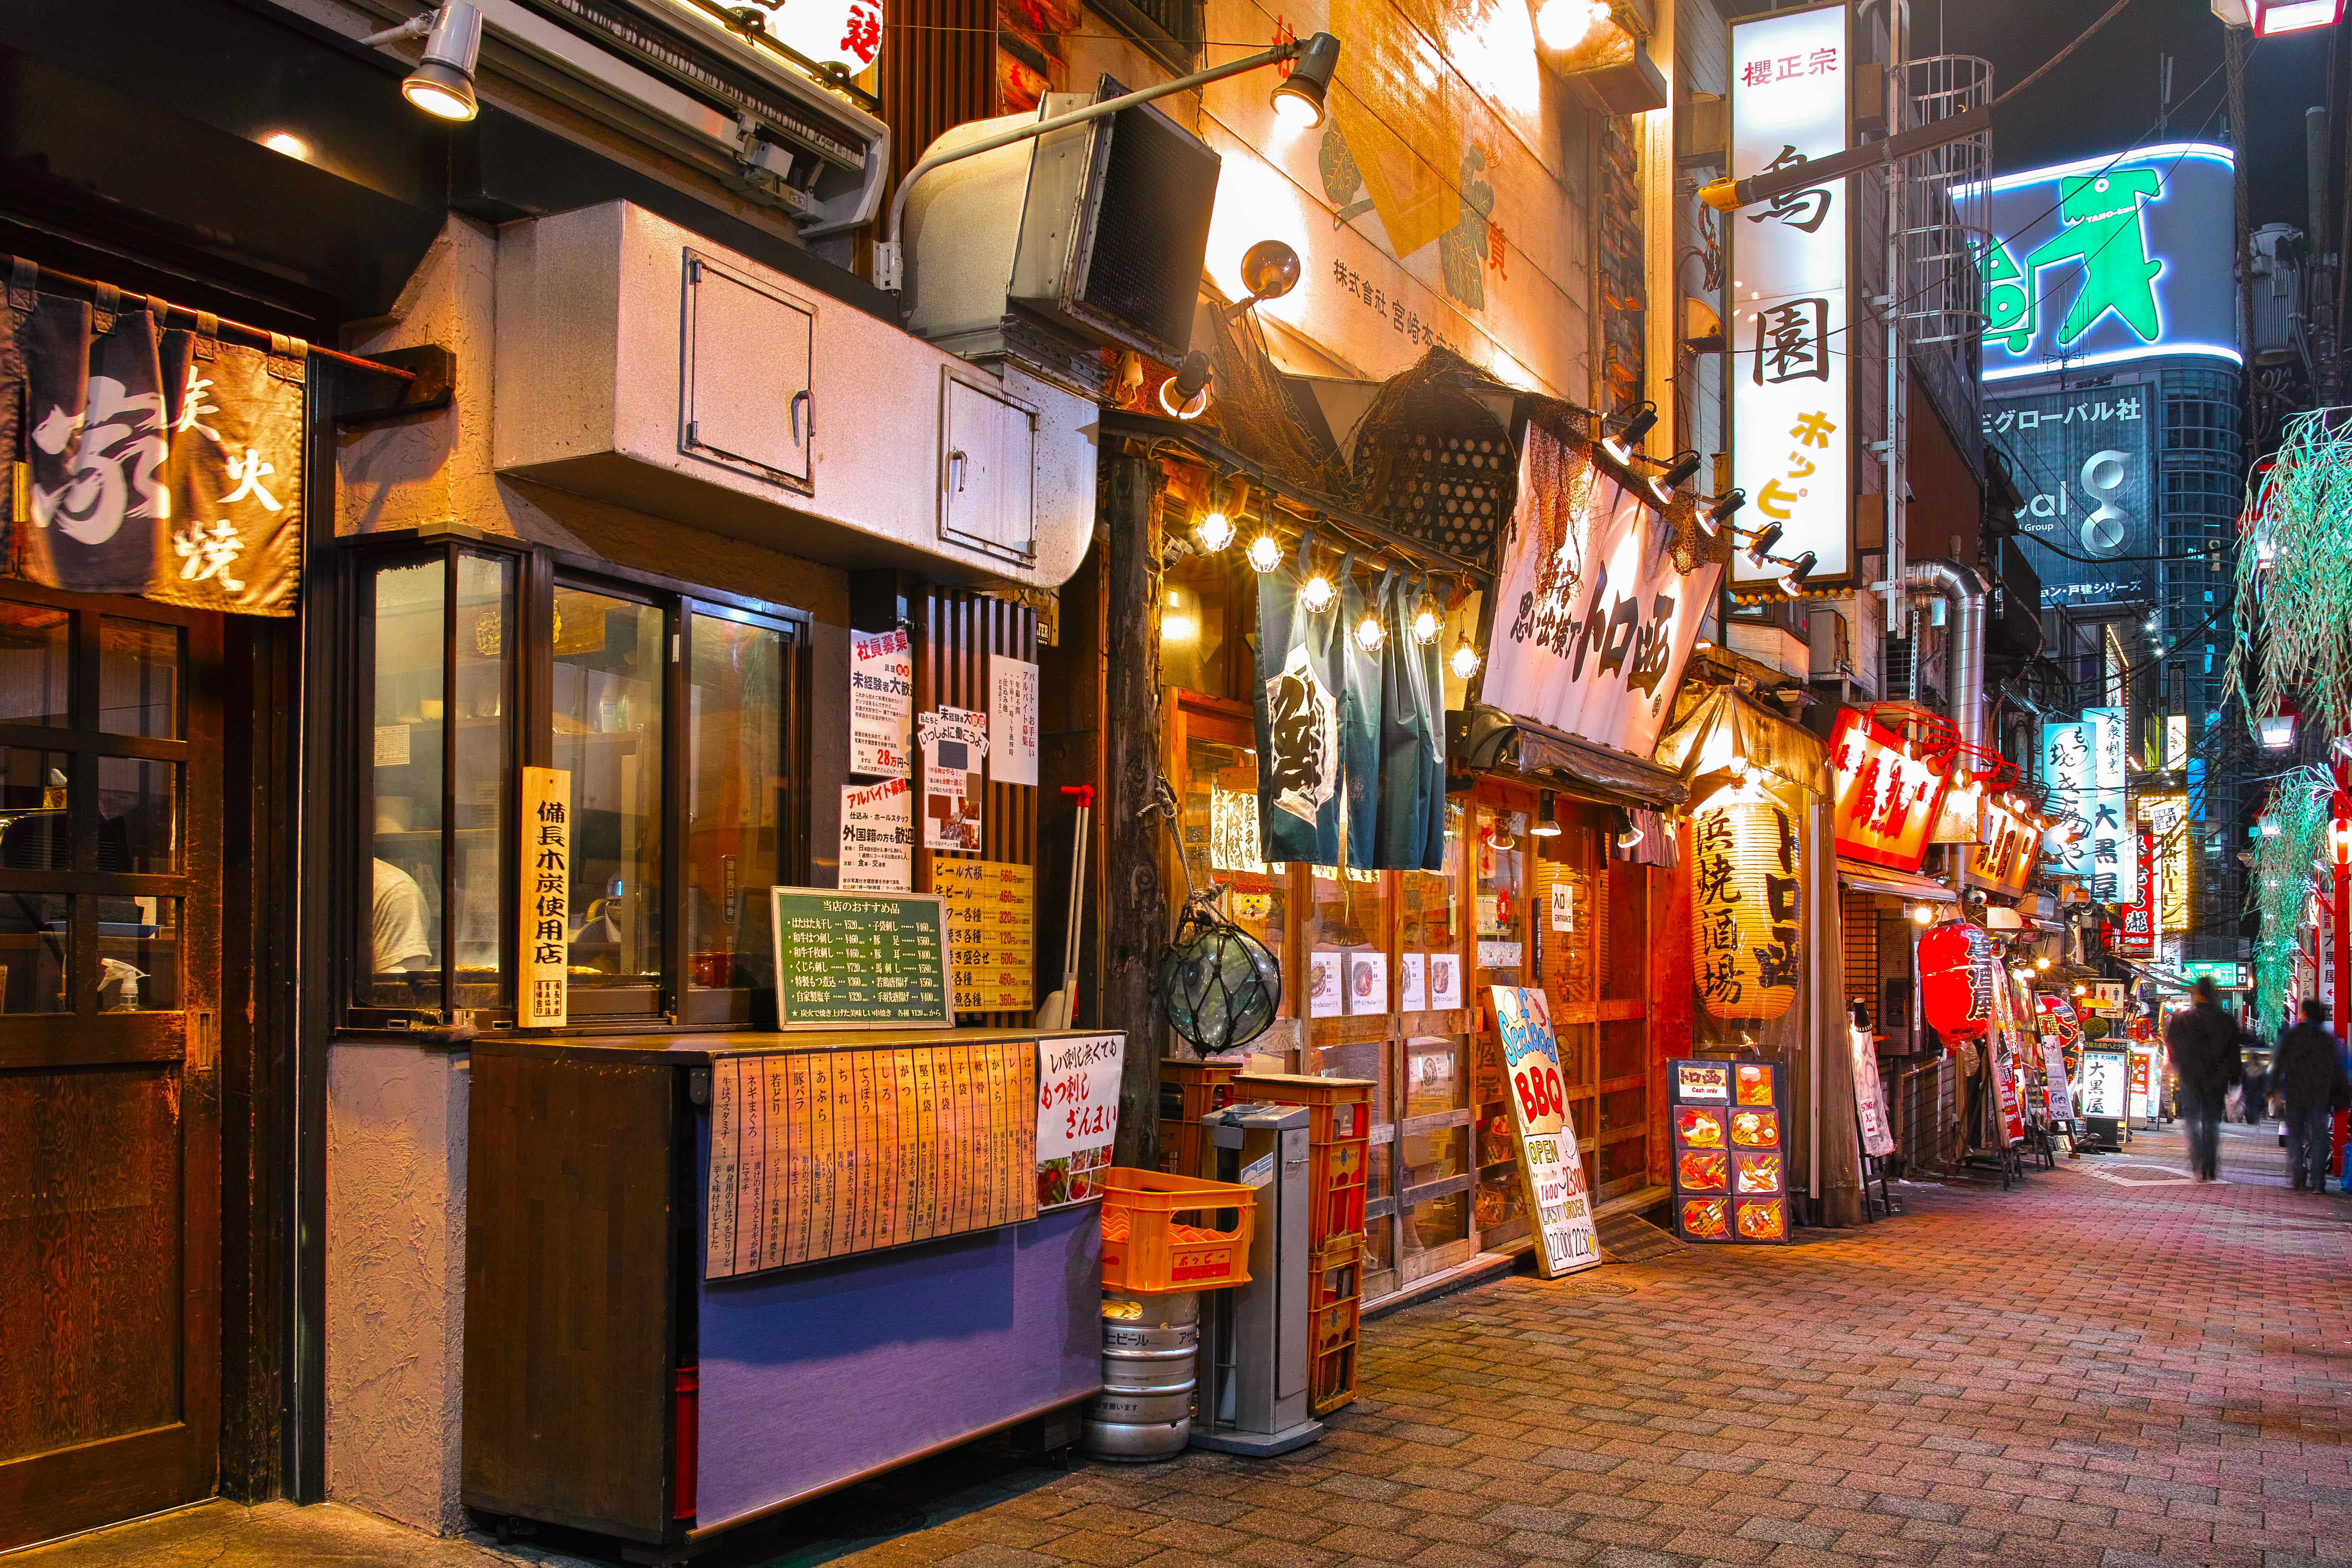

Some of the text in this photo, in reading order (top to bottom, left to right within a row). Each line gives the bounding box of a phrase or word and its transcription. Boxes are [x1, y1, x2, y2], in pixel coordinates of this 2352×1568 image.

[1740, 48, 1838, 87] 櫻正宗
[2024, 523, 2054, 532] Group
[856, 632, 907, 662] 社員募集
[920, 715, 938, 724] 私たちと
[847, 778, 906, 809] アルバイト募集
[850, 812, 908, 823] 仕込み・ホールスタッフ
[843, 824, 914, 845] 外国籍の方も歓迎
[534, 800, 566, 964] 備長木炭使用店
[936, 862, 983, 881] ビール大瓶
[823, 900, 900, 914] 当店のおすすめ品
[1697, 808, 1745, 1004] 浜焼酒場
[792, 918, 832, 930] はたはた丸干し
[872, 921, 899, 932] 子袋刺し
[1554, 914, 1572, 923] ENTRANCE
[792, 932, 834, 944] 和牛はつ刺し
[794, 946, 834, 958] 和牛千枚刺し
[796, 962, 828, 973] くじら刺し
[795, 976, 836, 988] 特製もつ煮込
[876, 977, 908, 988] 若鶏唐揚げ
[796, 990, 830, 1002] 自家製塩辛
[877, 992, 910, 1003] 手羽先唐揚げ
[897, 1009, 910, 1017] 各種
[929, 1009, 941, 1017] から
[1498, 987, 1558, 1068] Seafood
[1050, 1038, 1117, 1074] レバ刺し無くても
[882, 1066, 891, 1100] しろ
[900, 1064, 910, 1096] がつ
[956, 1062, 967, 1095] 子袋
[2086, 1062, 2105, 1114] 大黒屋
[770, 1074, 780, 1116] 若どり
[794, 1072, 804, 1111] 豚バラ
[816, 1072, 827, 1122] あぶら
[860, 1068, 871, 1114] てっぽう
[1042, 1072, 1091, 1110] もつ刺し
[1514, 1066, 1565, 1124] BBQ
[720, 1076, 732, 1140] 牛はつスタミナ
[748, 1075, 757, 1138] ネギまぐろ
[1066, 1104, 1118, 1139] ざんまい
[1528, 1140, 1560, 1164] OPEN
[1562, 1198, 1587, 1220] ORDER
[1179, 1252, 1225, 1266] ホッピー
[1104, 1332, 1149, 1346] ヒビール
